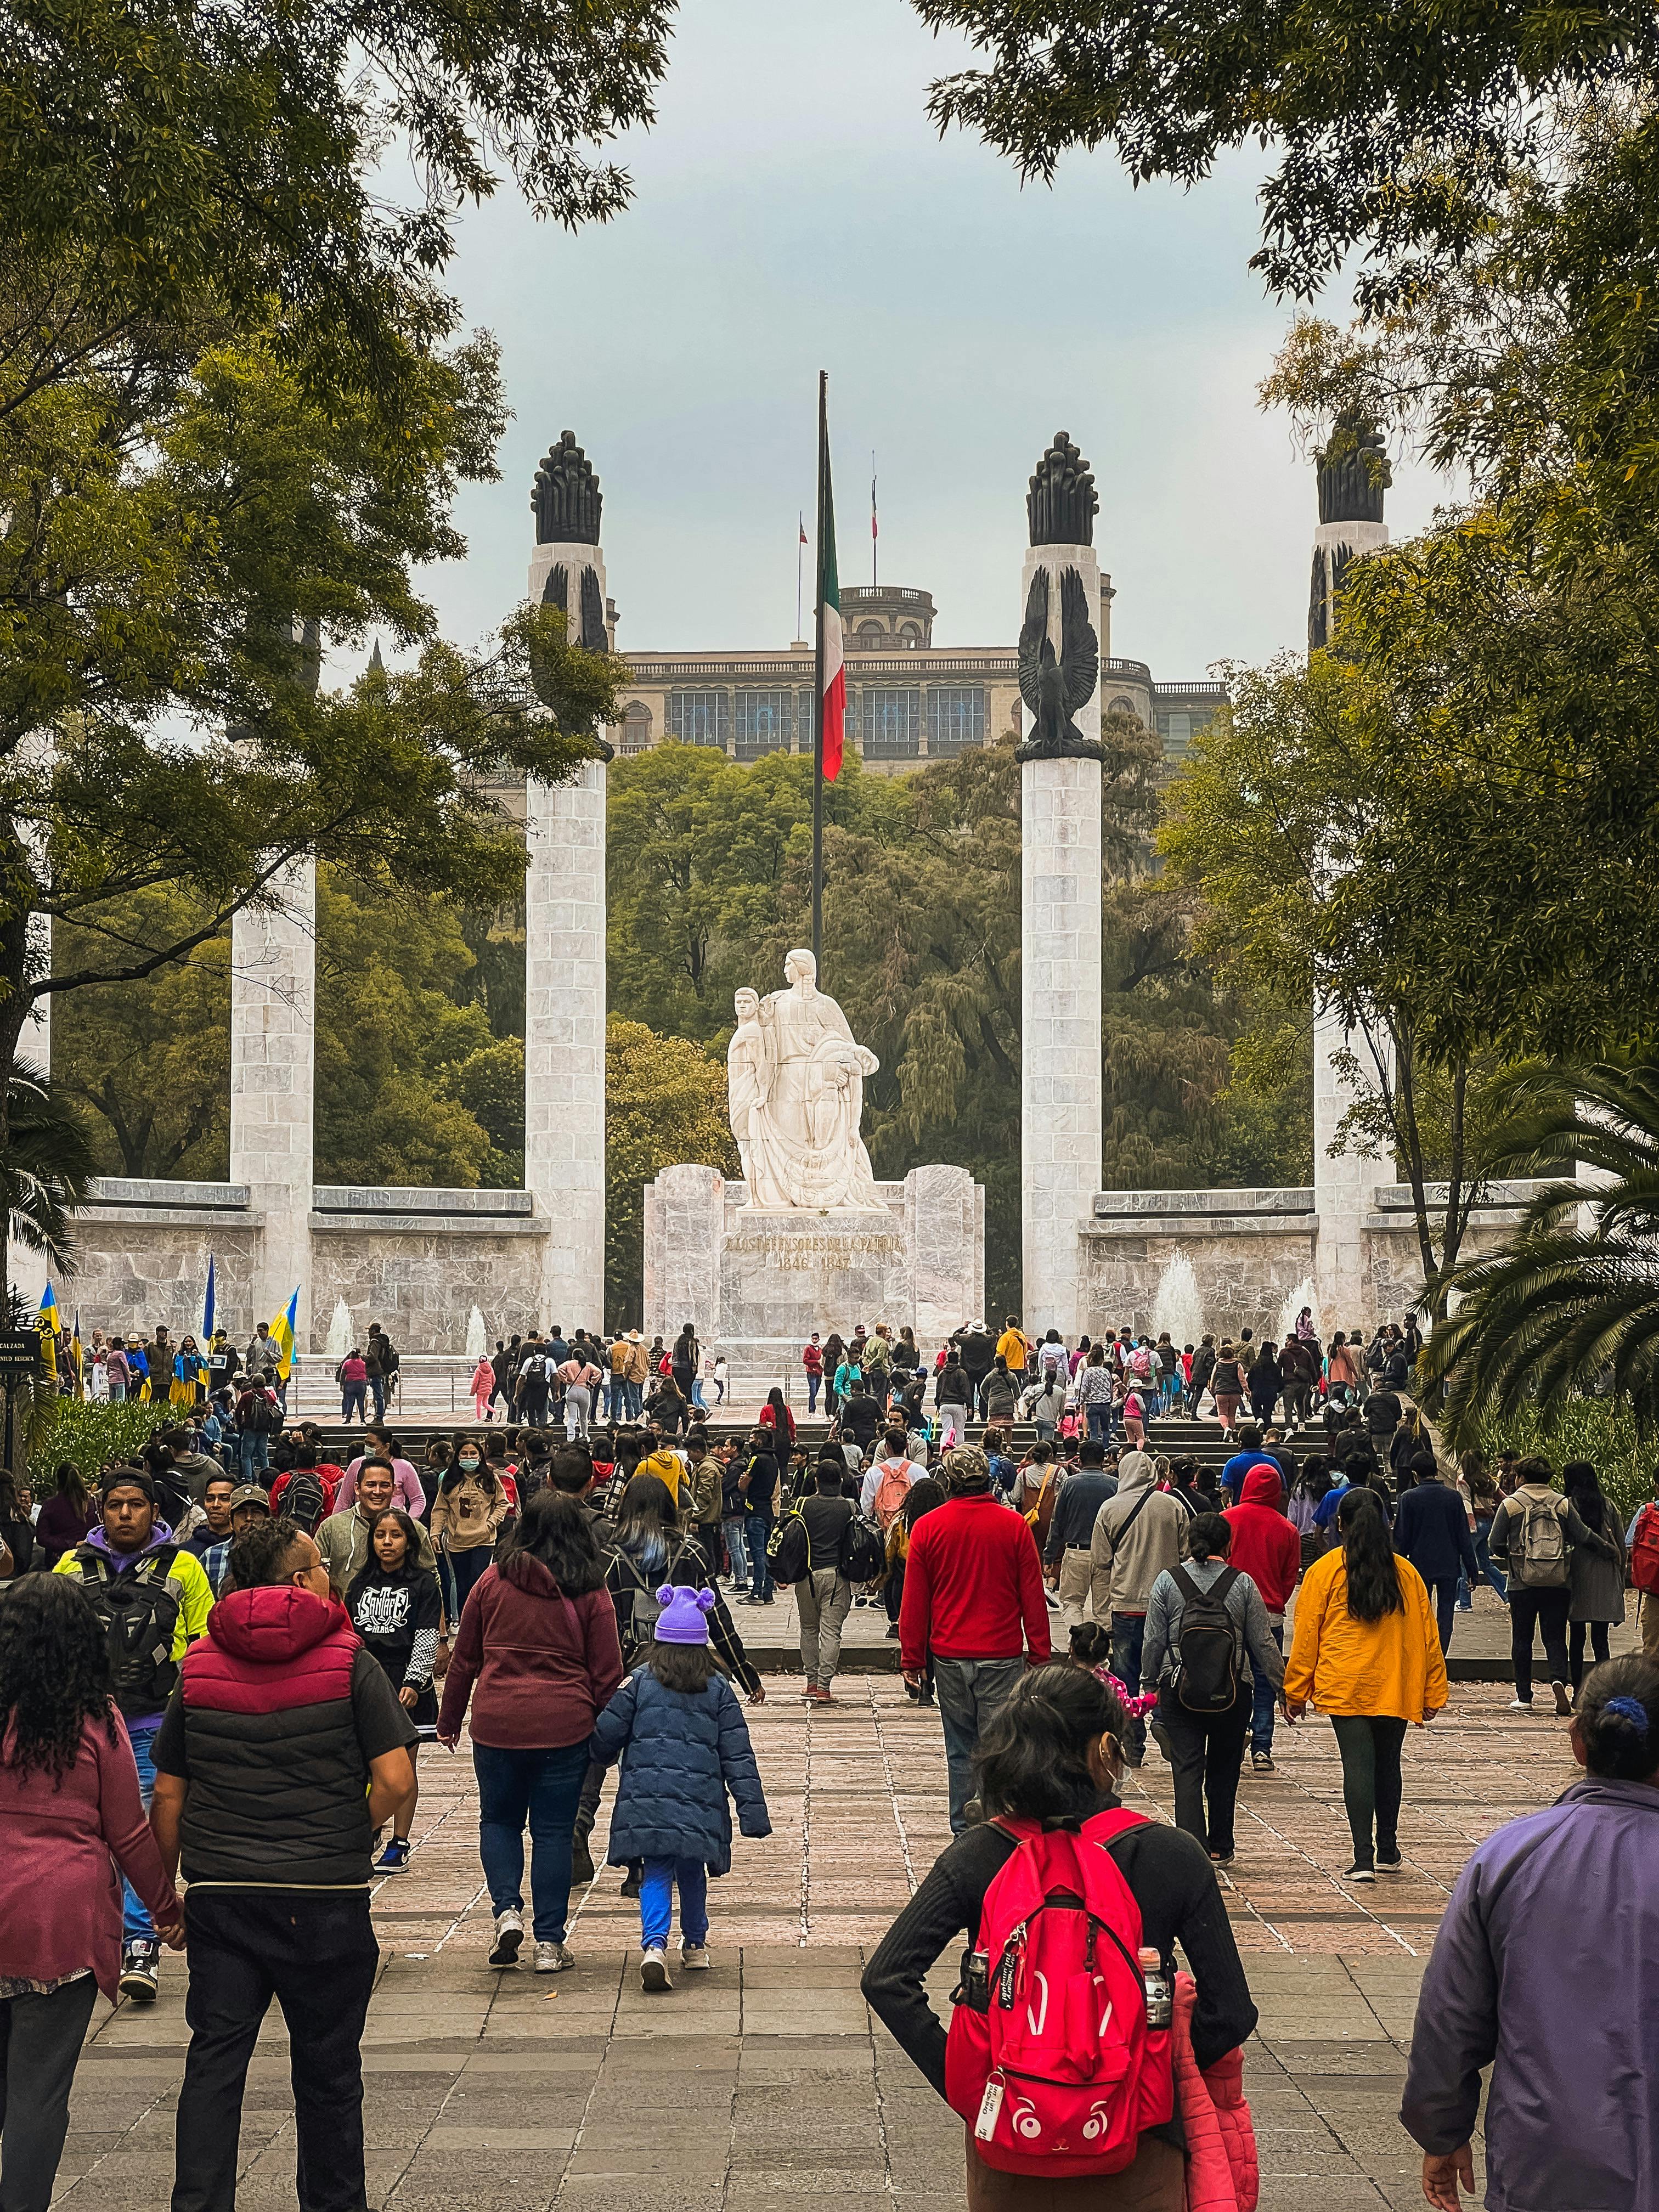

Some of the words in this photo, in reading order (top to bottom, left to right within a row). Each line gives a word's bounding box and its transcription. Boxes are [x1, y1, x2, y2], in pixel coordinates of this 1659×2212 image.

[726, 1238, 733, 1250] A
[736, 1238, 755, 1250] LOS
[757, 1237, 825, 1251] DEFENSORES
[827, 1237, 840, 1251] DE
[843, 1237, 855, 1250] LA
[860, 1237, 903, 1251] PATRIA
[778, 1258, 808, 1271] 1846
[822, 1258, 850, 1271] 1847
